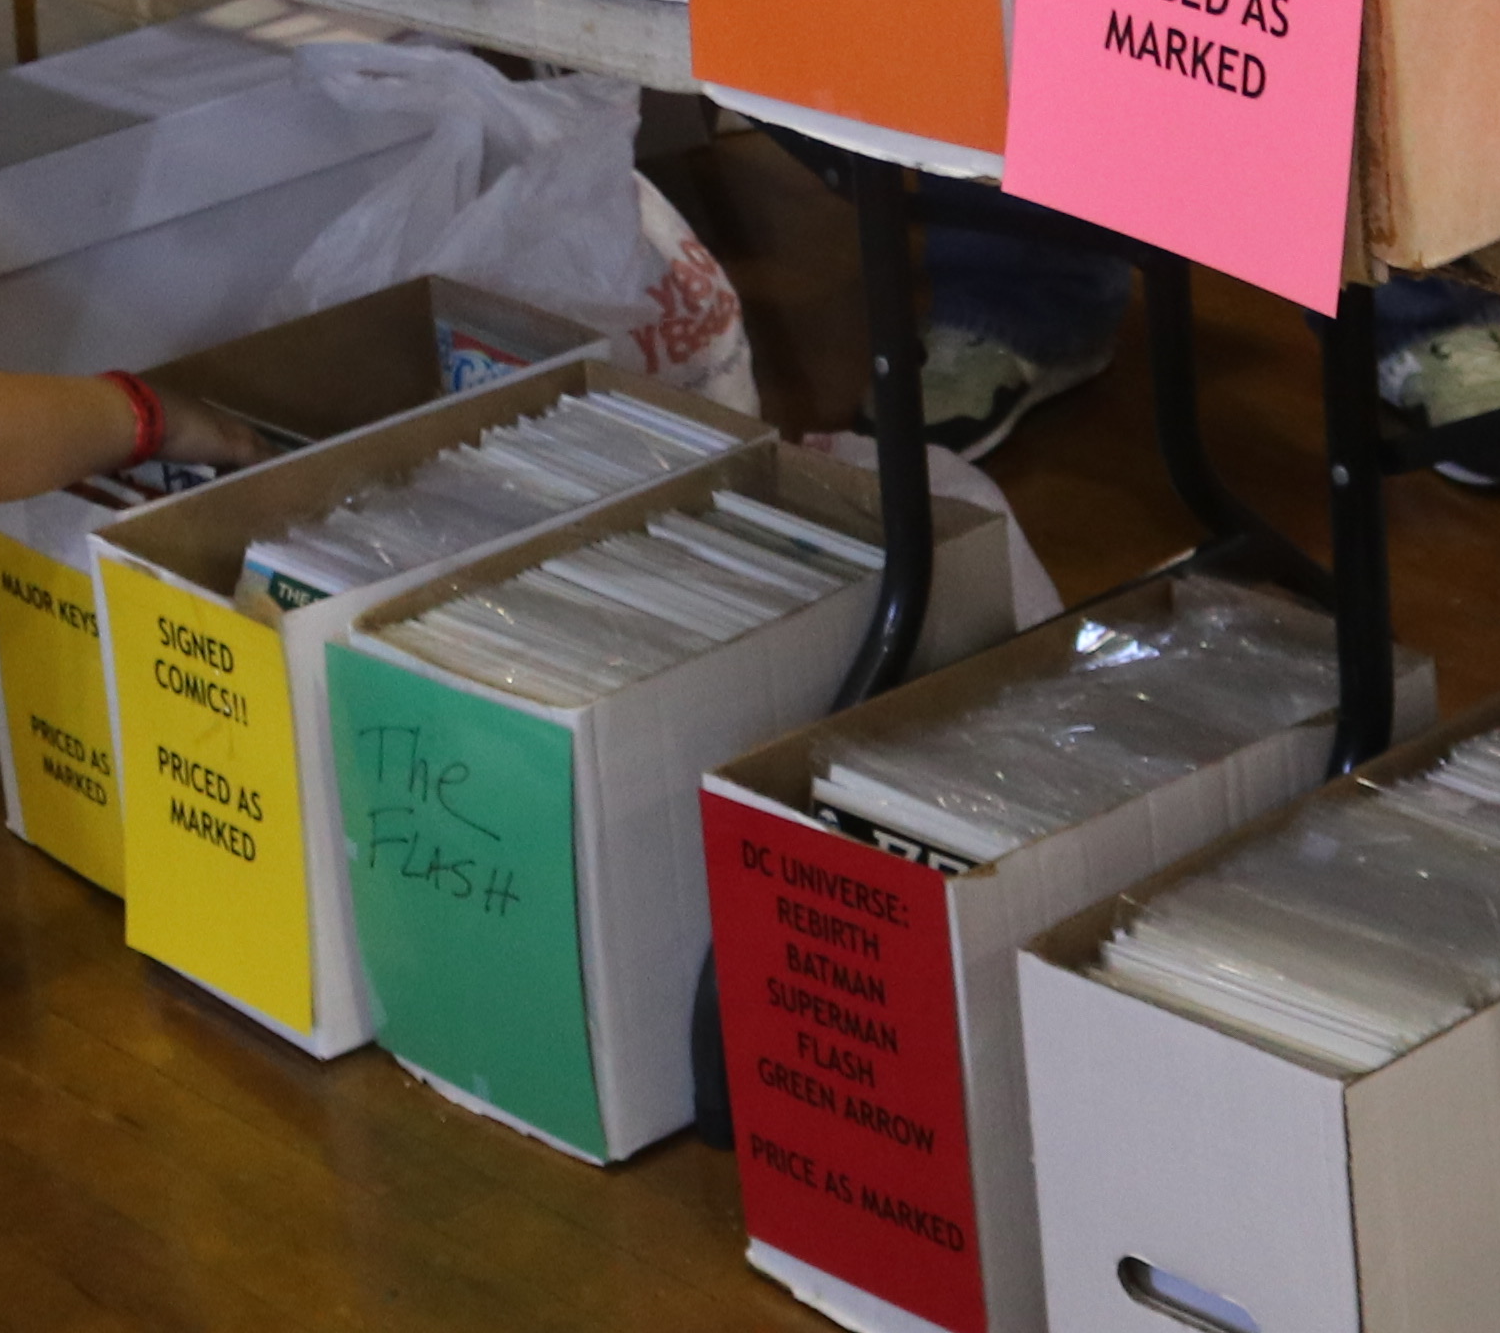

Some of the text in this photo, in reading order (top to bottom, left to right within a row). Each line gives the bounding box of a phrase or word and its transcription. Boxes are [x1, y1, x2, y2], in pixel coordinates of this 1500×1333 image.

[1103, 10, 1268, 100] MARKED
[0, 569, 100, 638] MAJOR KEYS
[158, 616, 235, 675] SIGNED
[154, 659, 250, 727] COMICS!!
[30, 714, 111, 776] PRICED AS
[41, 755, 108, 807] MARKED
[157, 744, 264, 821] PRICED AS
[359, 725, 501, 841] The
[170, 796, 257, 862] MARKED
[367, 807, 520, 917] FLASH
[740, 839, 910, 928] DC UNIVERSE:
[776, 896, 880, 962] REBIRTH
[786, 944, 886, 1006] BATMAN
[766, 979, 898, 1054] SUPERMAN
[797, 1033, 876, 1088] FLASH
[757, 1057, 935, 1154] GREEN ARROW
[750, 1134, 965, 1252] PRICE AS MARKED
